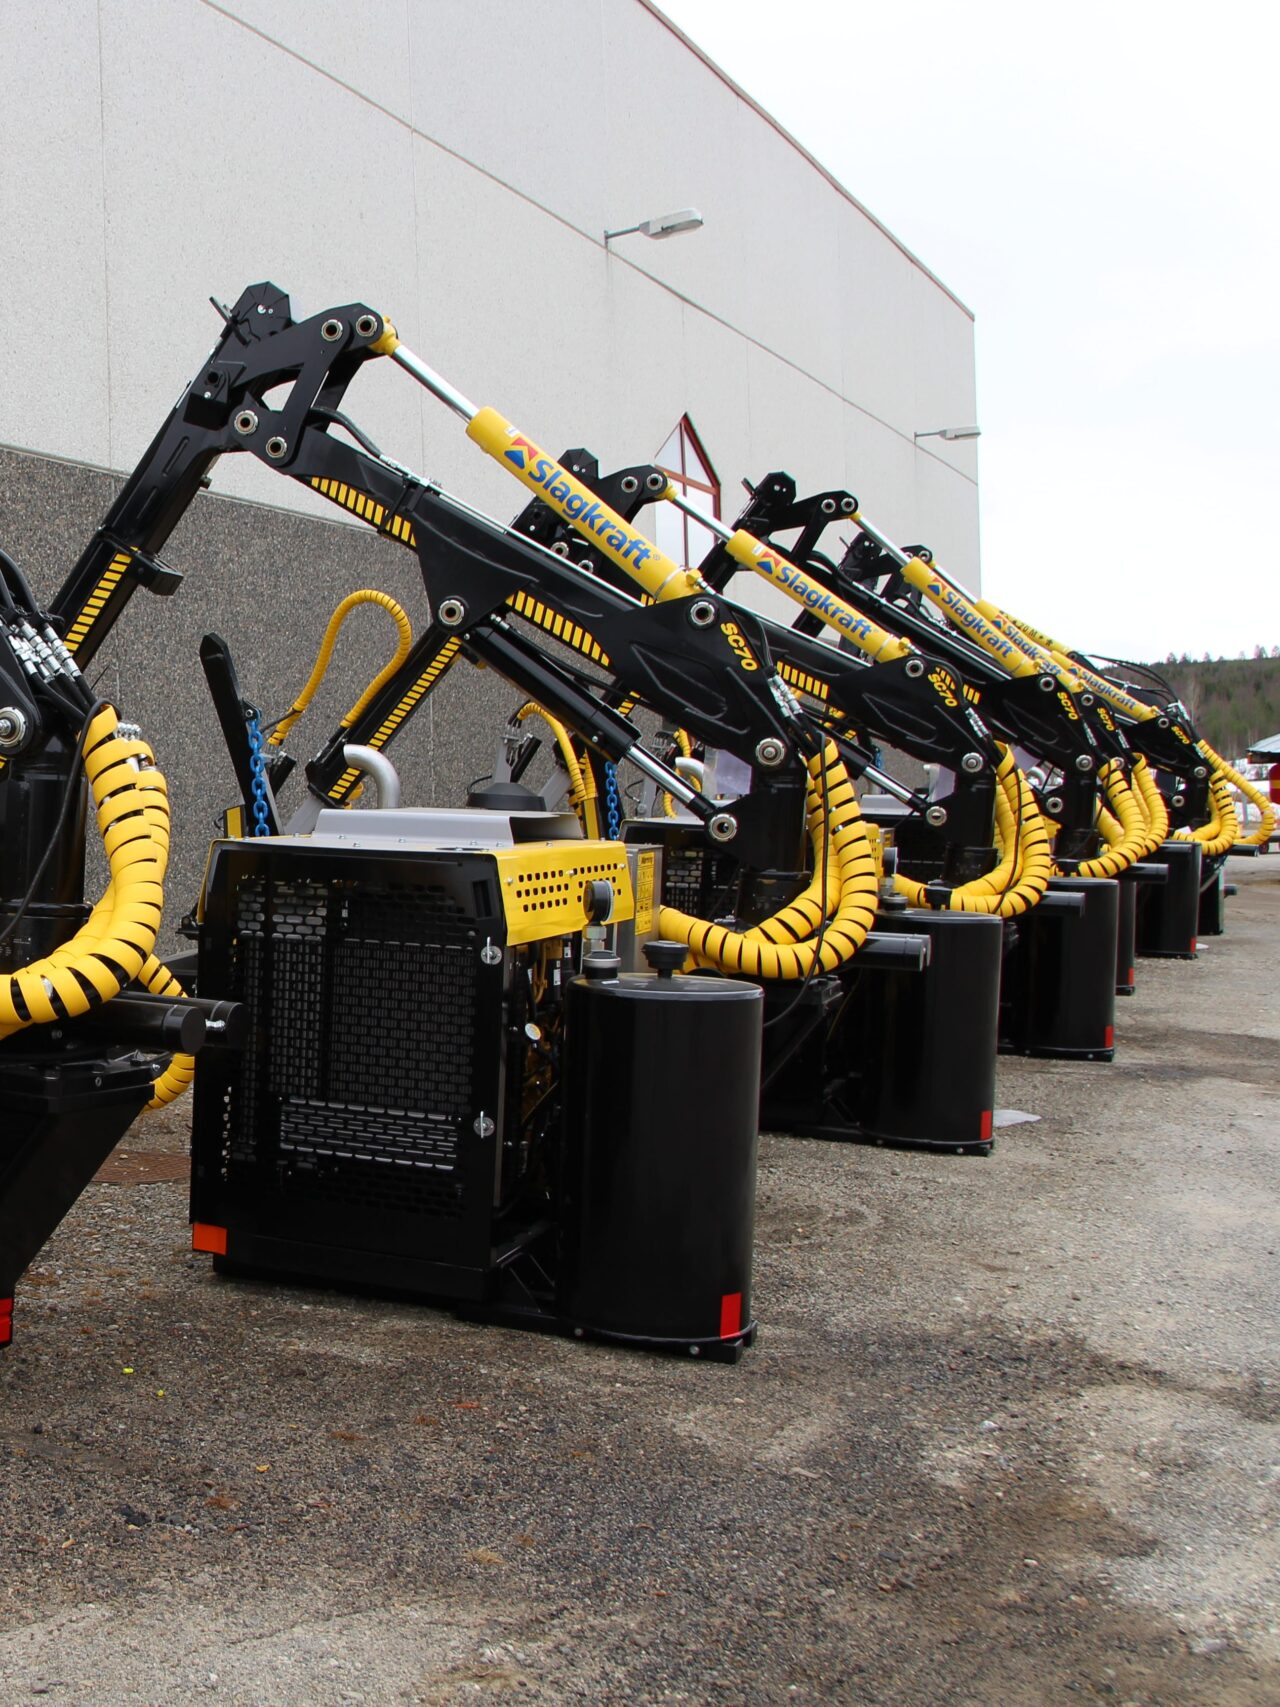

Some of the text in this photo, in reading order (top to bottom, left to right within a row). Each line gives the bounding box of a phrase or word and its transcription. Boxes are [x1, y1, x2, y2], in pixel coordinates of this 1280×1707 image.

[528, 459, 652, 571] Slagkraft
[775, 563, 873, 641] Slagkraft
[720, 622, 758, 671] SC70
[941, 591, 1013, 658] Slagkraft
[927, 673, 958, 707] SC70
[1056, 691, 1079, 721] SC70
[1081, 671, 1137, 711] Slagkraft
[1096, 707, 1115, 732] SC70
